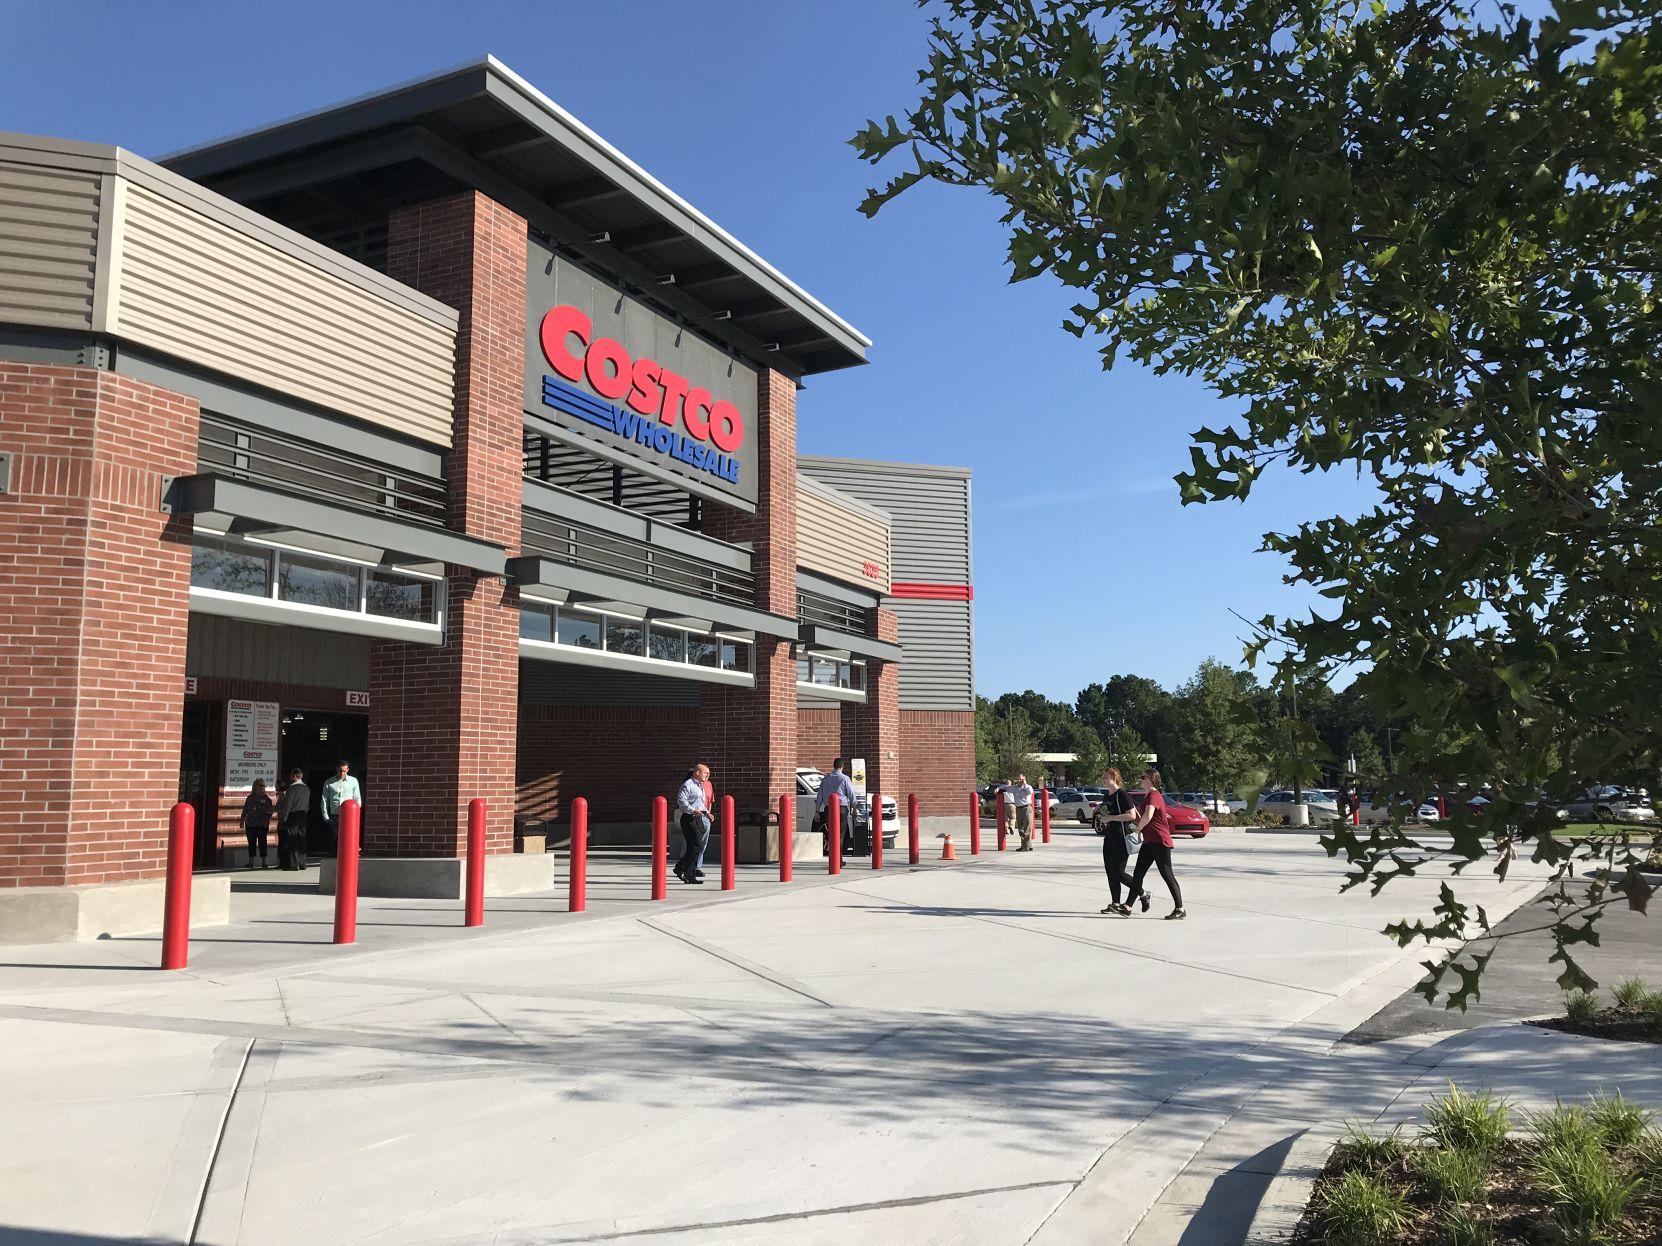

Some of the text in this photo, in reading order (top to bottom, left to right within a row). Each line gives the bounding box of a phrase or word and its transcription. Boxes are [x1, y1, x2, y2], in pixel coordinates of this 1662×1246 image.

[539, 305, 744, 452] COSTCO
[610, 405, 741, 484] WHOLESALE
[350, 693, 369, 704] EXI
